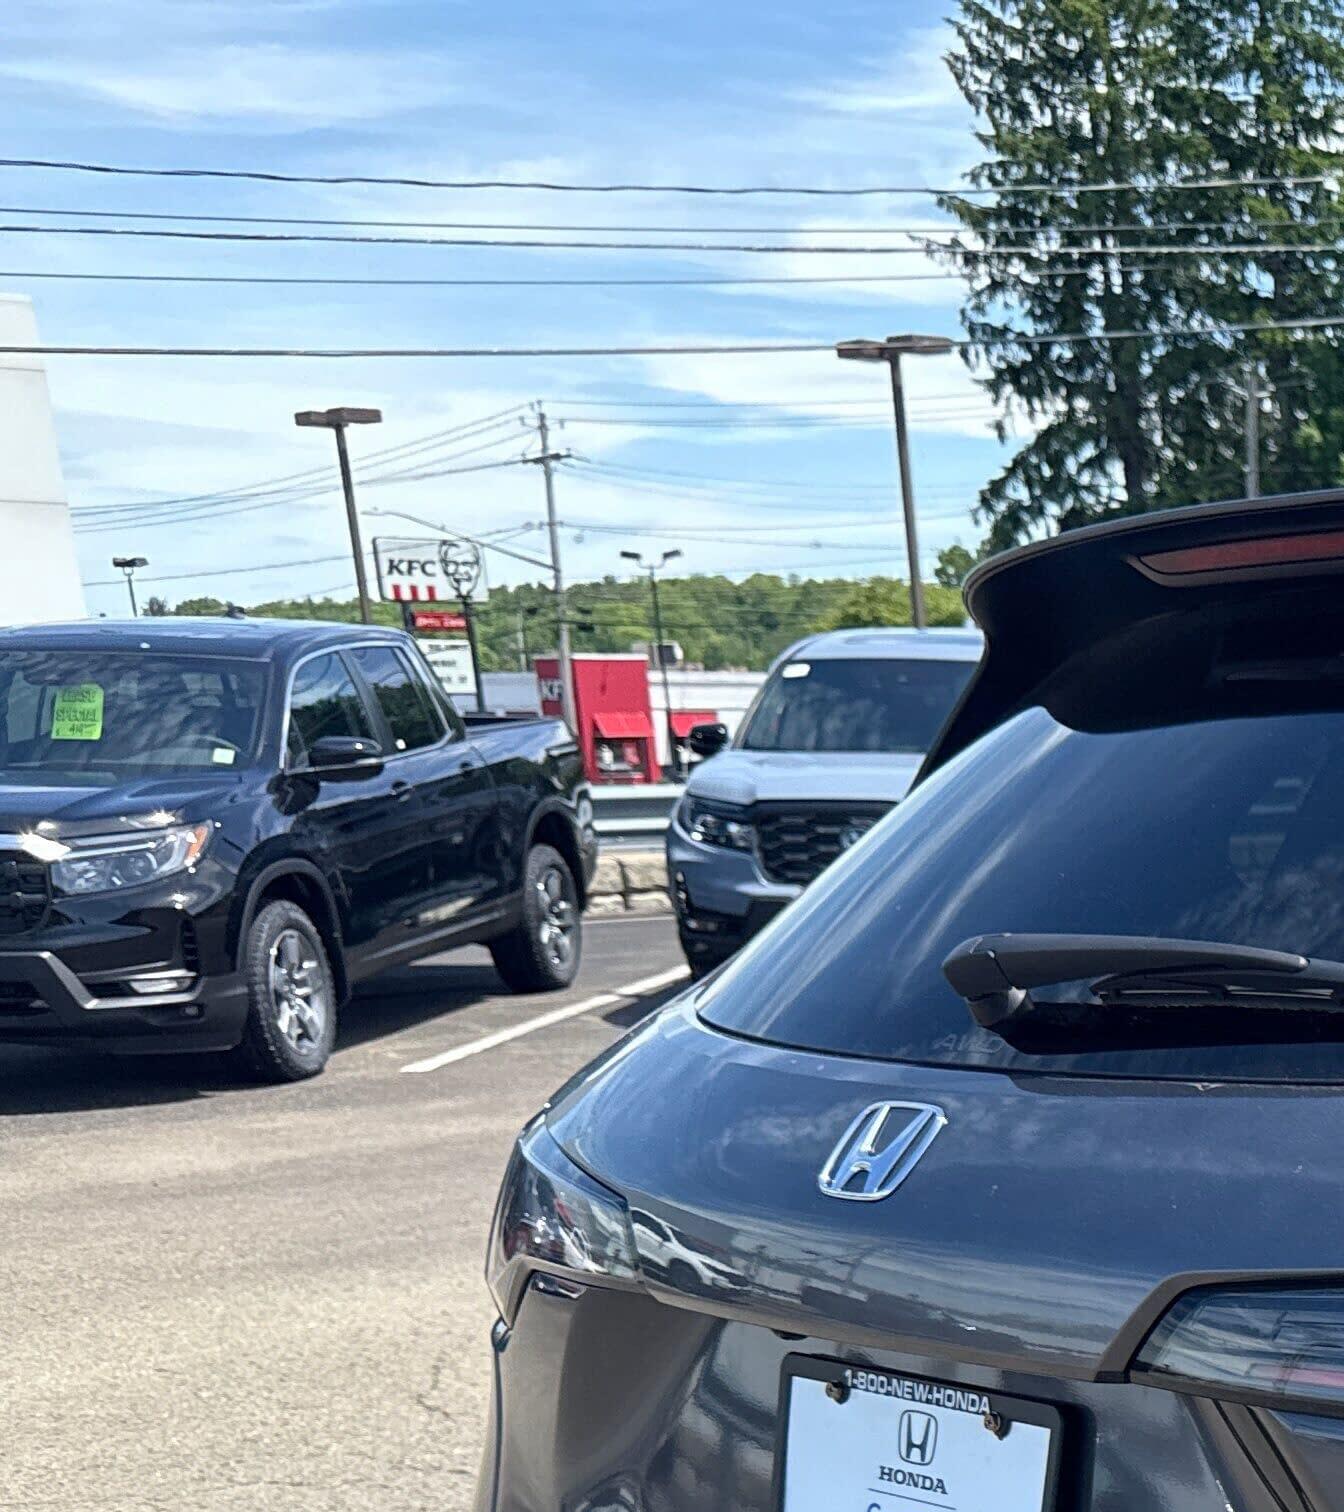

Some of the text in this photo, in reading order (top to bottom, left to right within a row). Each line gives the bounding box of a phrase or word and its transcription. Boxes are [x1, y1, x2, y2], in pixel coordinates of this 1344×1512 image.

[387, 558, 437, 577] KFC
[844, 1368, 991, 1414] 1-800-NEW-HONDA
[878, 1465, 949, 1496] HONDA
